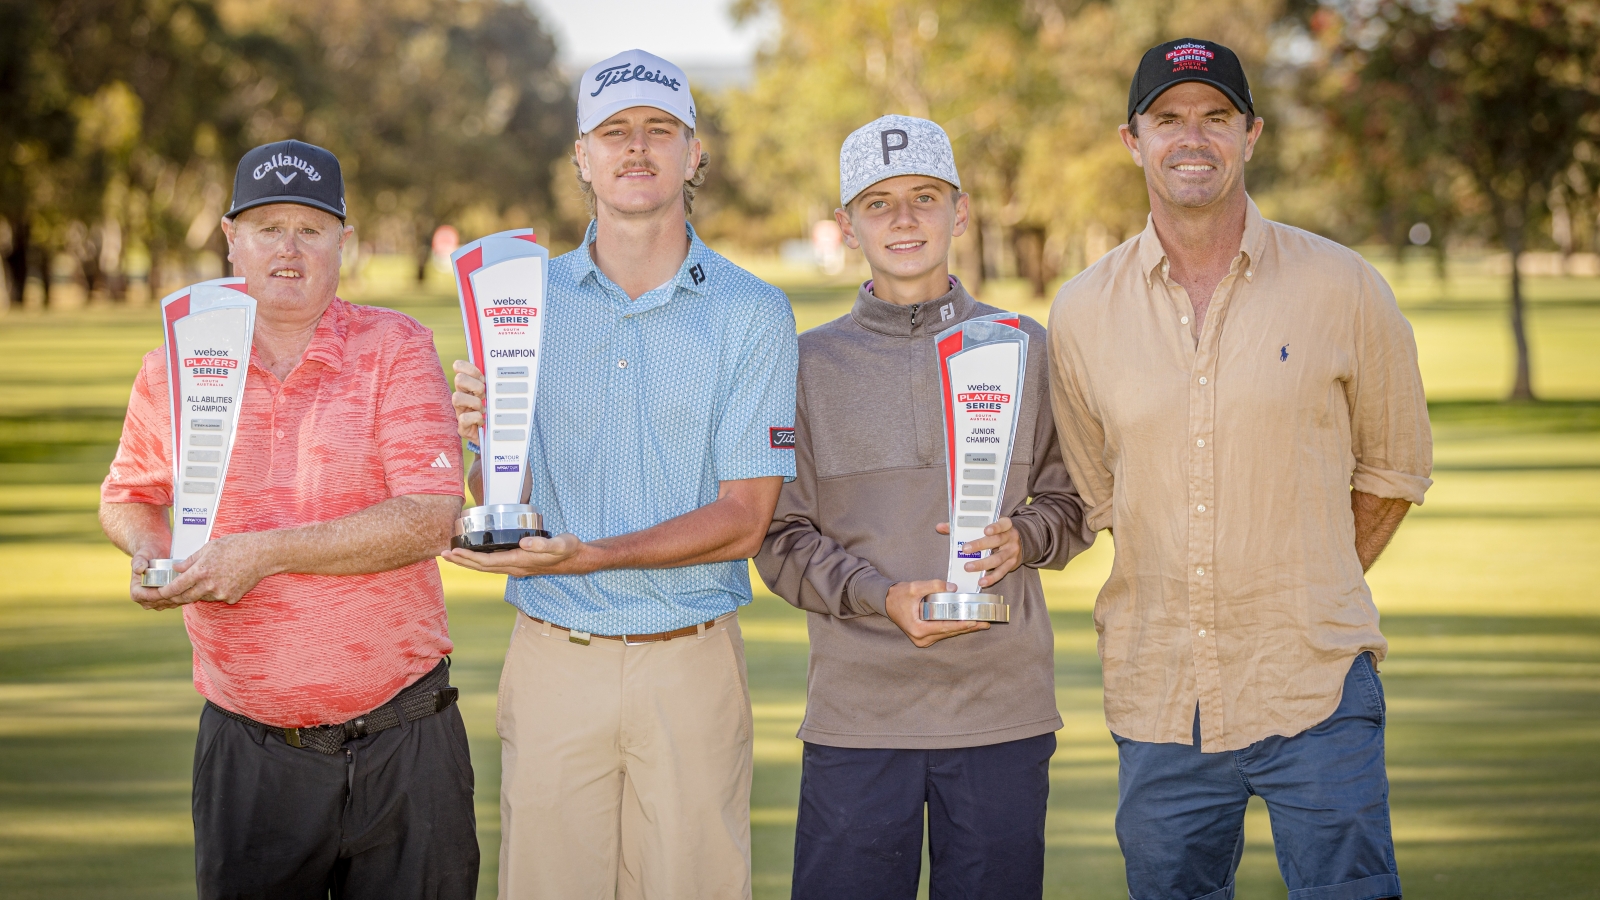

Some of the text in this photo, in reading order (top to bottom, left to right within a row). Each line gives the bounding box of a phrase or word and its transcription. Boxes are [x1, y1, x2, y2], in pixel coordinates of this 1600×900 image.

[1174, 42, 1206, 50] webex
[1167, 48, 1213, 60] PLAYERS
[1172, 54, 1207, 62] SERIES
[1172, 65, 1209, 73] AUSTRALIA
[590, 62, 681, 97] Titleist
[881, 129, 909, 165] P
[253, 152, 322, 182] Callaway
[493, 296, 528, 306] webex
[485, 307, 536, 317] PLAYERS
[492, 316, 529, 324] SERIES
[194, 347, 229, 357] webex
[489, 348, 536, 358] CHAMPION
[186, 358, 237, 368] PLAYERS
[192, 367, 229, 376] SERIES
[967, 382, 1002, 392] webex
[187, 395, 233, 404] ALL ABILITIES
[959, 393, 1009, 402] PLAYERS
[191, 404, 228, 413] CHAMPION
[965, 402, 1002, 410] SERIES
[970, 427, 996, 435] JUNIOR
[965, 436, 1000, 444] CHAMPION
